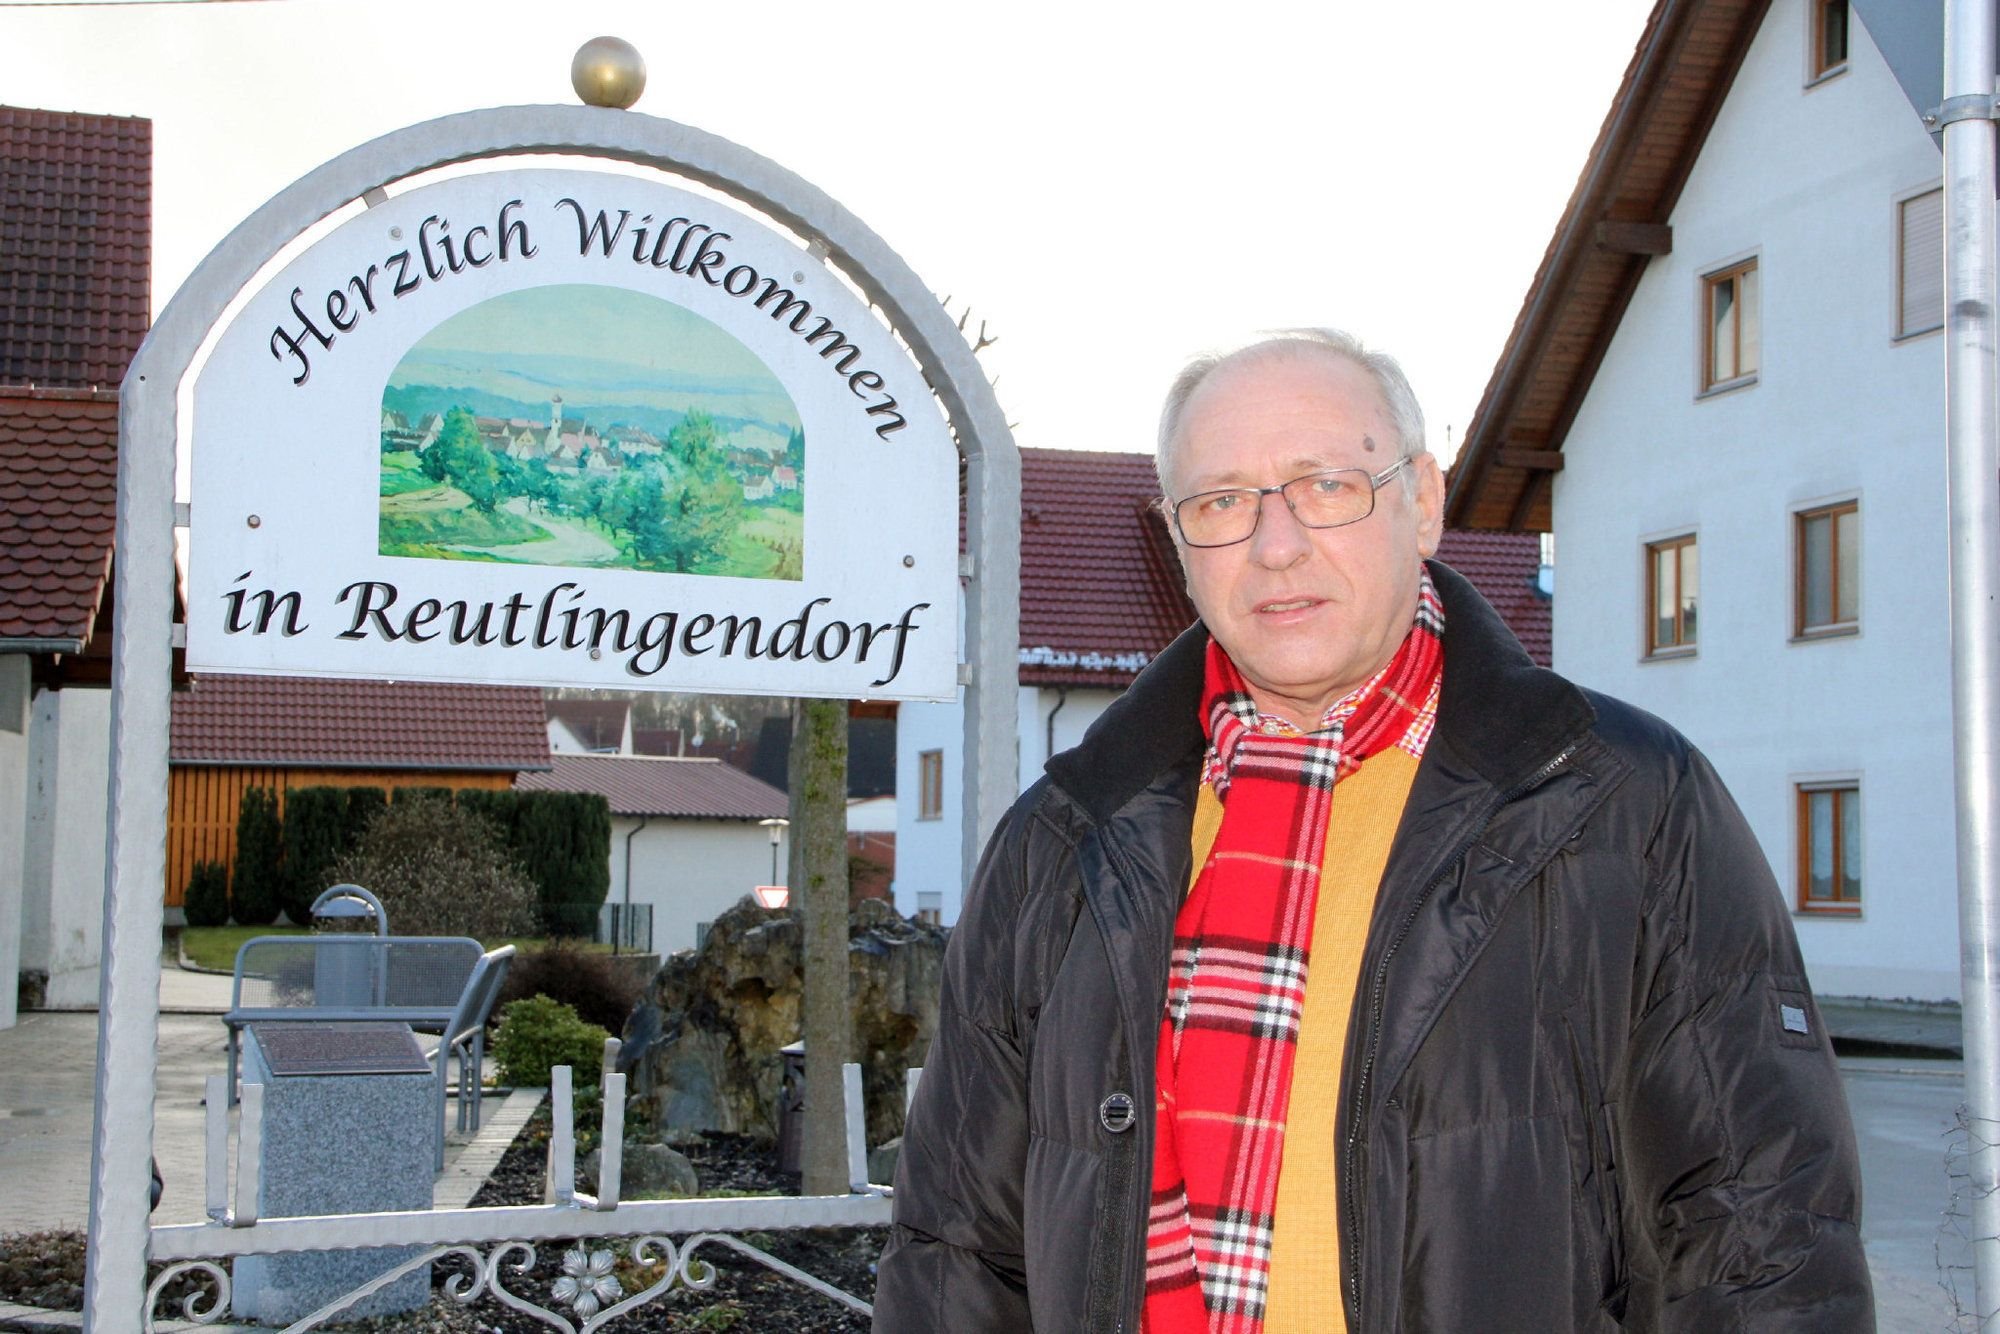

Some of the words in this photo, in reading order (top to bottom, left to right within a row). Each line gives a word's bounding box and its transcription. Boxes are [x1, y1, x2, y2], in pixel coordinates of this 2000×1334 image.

[270, 199, 539, 386] Herzlich
[554, 198, 908, 442] Willkommen
[221, 570, 310, 637] in
[335, 581, 931, 687] Reutlingendorf
